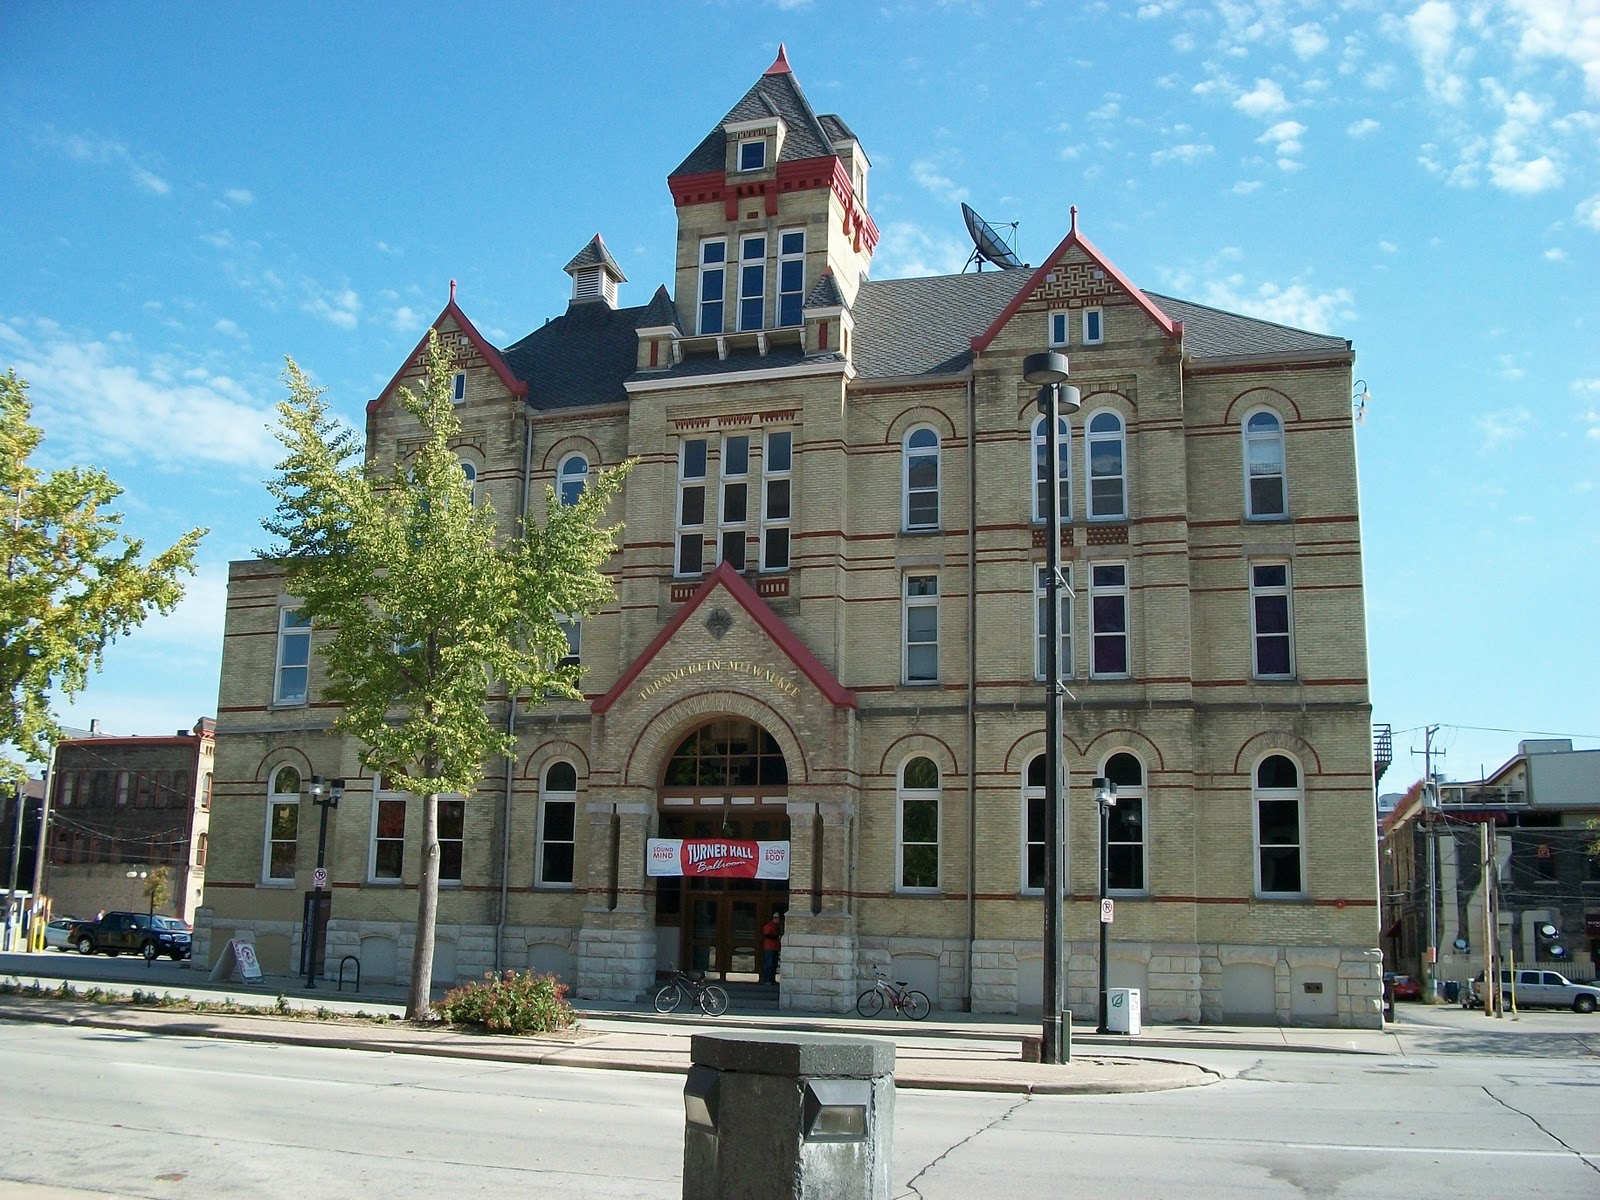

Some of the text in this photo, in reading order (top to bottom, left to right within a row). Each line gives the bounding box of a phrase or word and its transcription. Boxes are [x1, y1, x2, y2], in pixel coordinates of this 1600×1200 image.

[638, 660, 800, 700] TURNVEREIN MILWAUKEE
[687, 844, 754, 865] TURNER HALL
[765, 854, 785, 862] BODY
[696, 860, 746, 873] Ballroom
